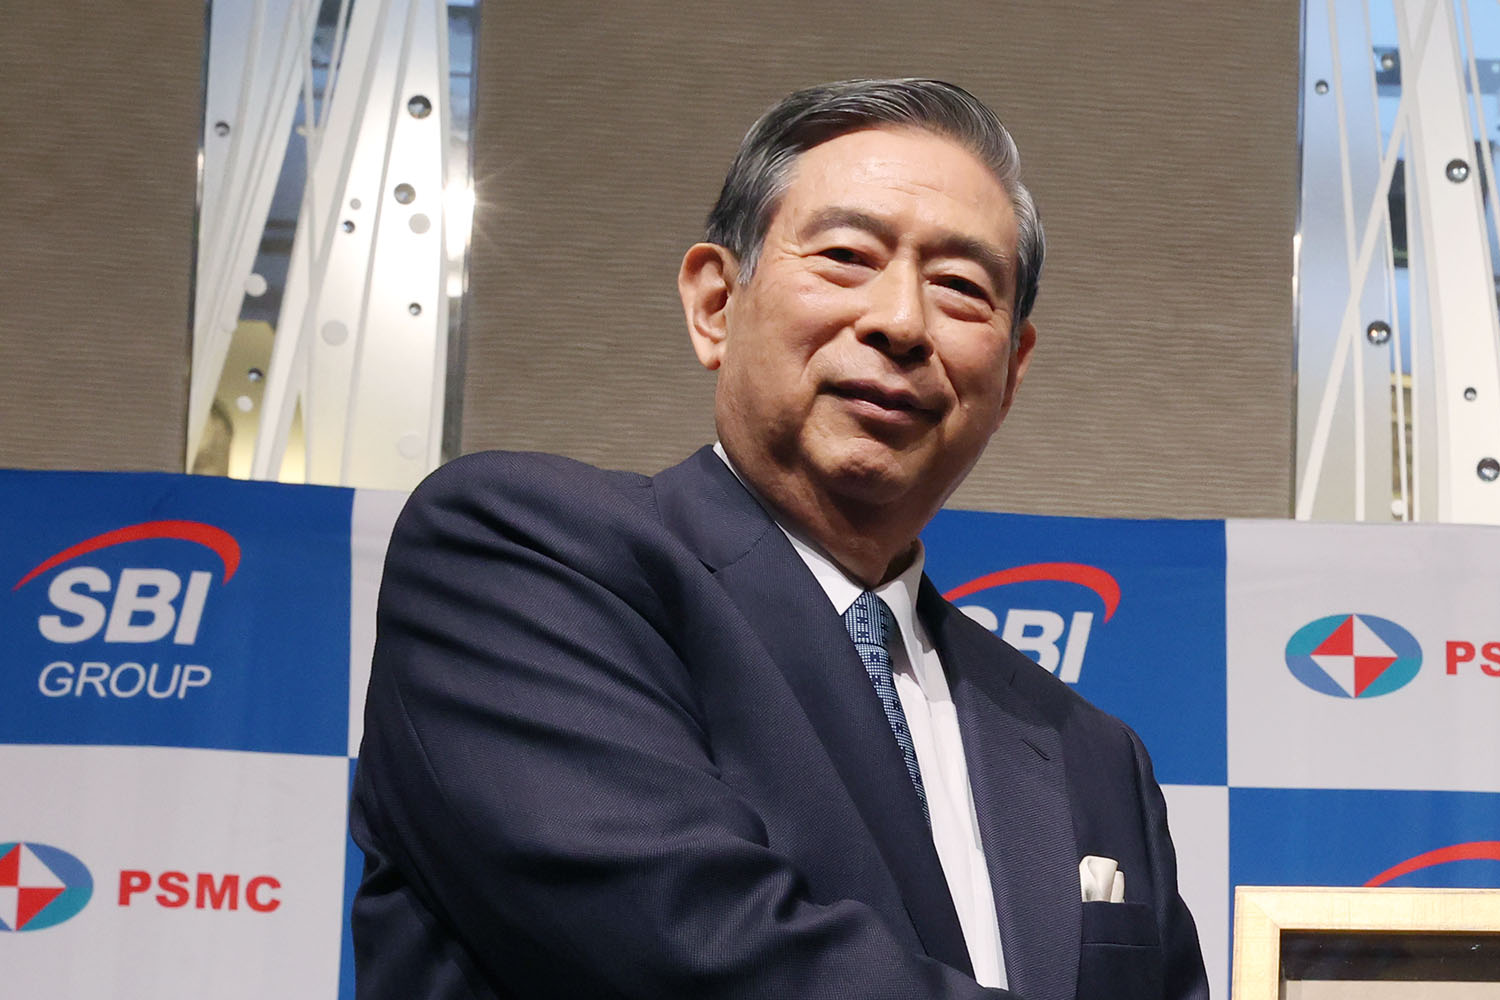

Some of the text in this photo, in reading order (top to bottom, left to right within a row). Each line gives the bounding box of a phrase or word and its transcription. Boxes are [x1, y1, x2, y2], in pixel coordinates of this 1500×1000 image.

[38, 566, 212, 646] SBI
[38, 661, 212, 699] GROUP
[117, 870, 282, 913] PSMC
